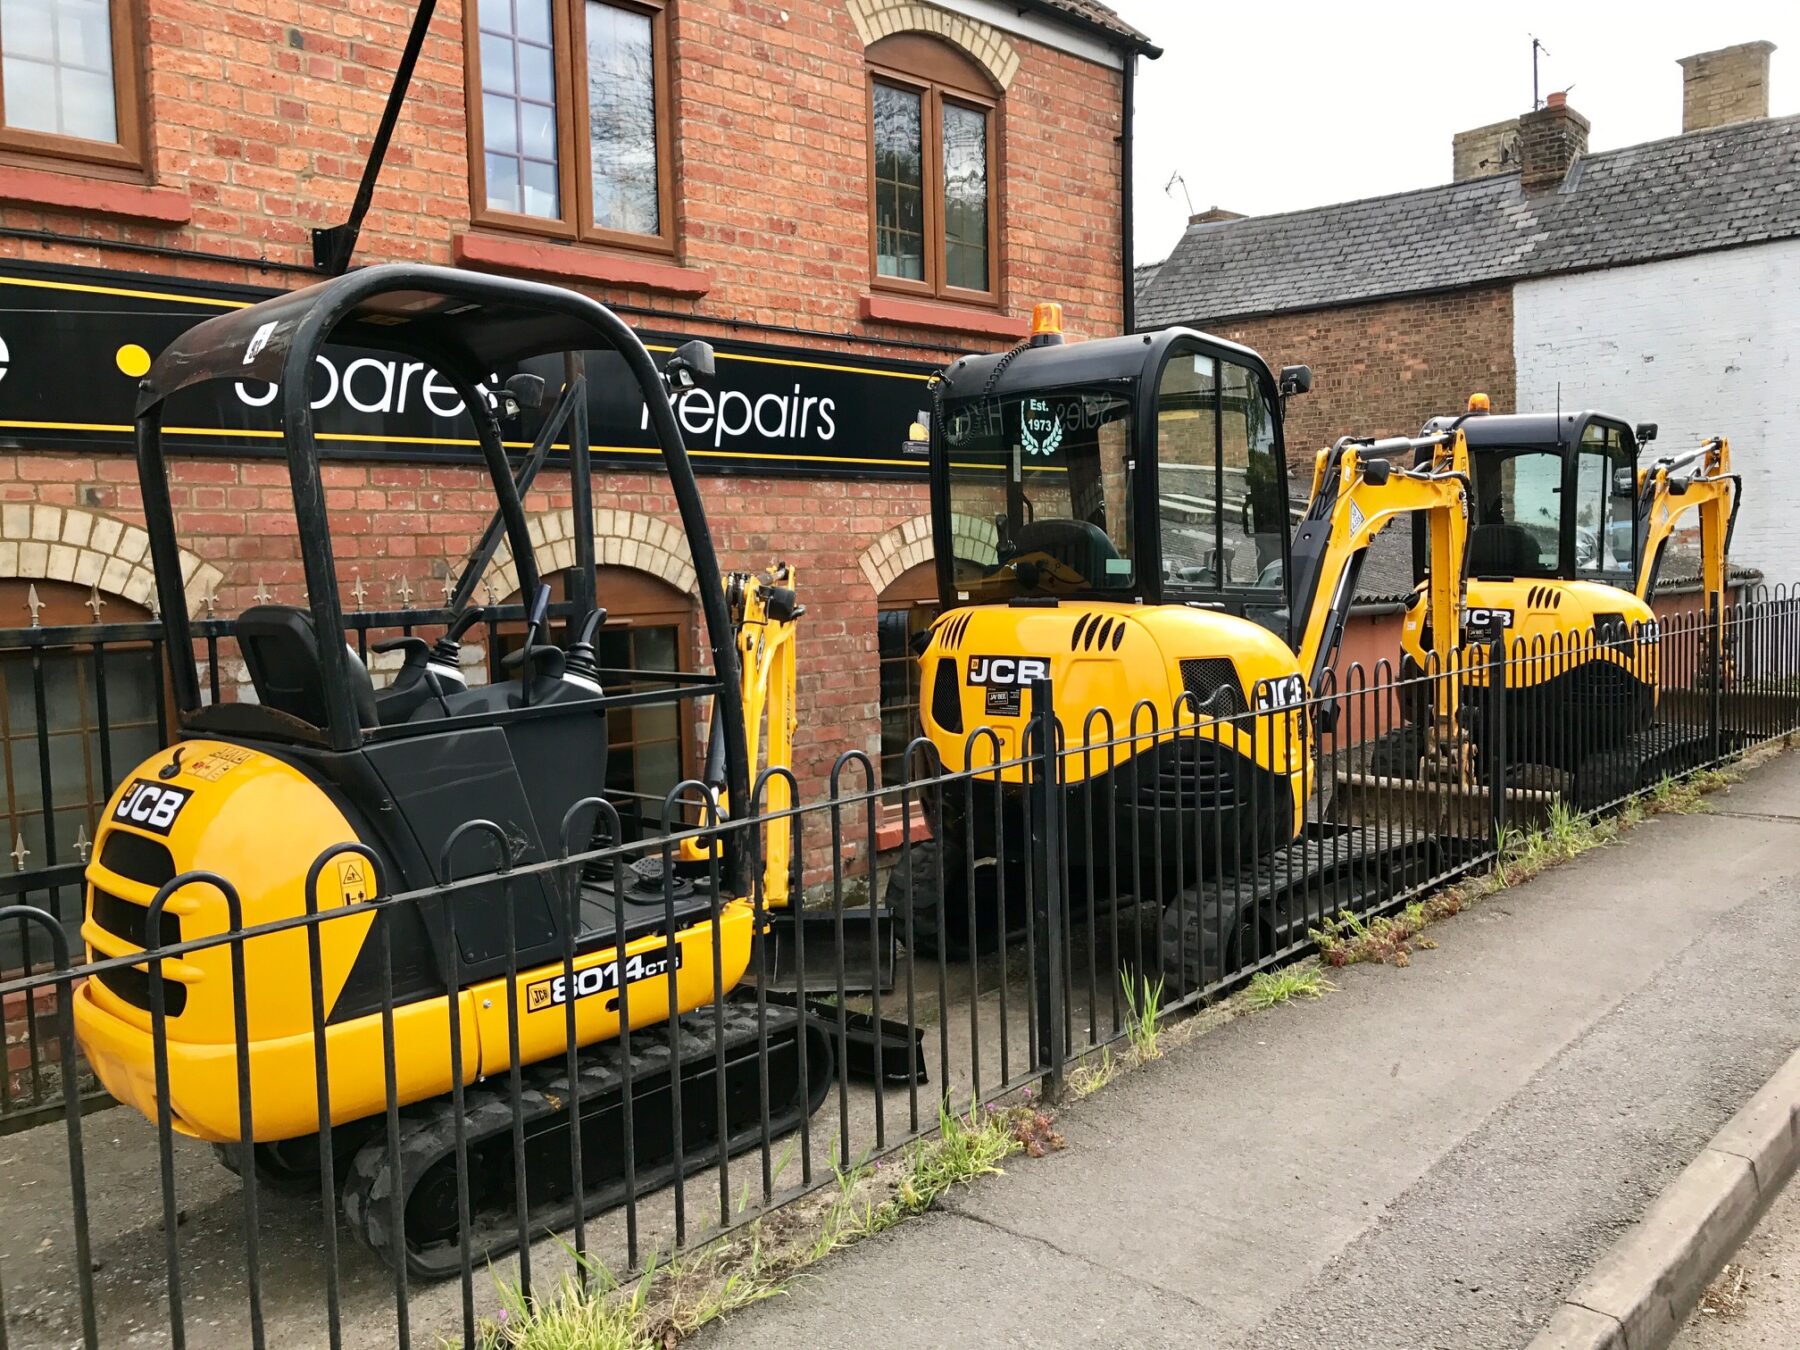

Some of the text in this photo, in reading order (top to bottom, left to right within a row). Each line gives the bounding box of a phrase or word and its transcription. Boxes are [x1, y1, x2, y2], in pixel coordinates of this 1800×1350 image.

[1030, 399, 1049, 412] Est.
[1028, 418, 1052, 431] 1973
[970, 659, 1046, 685] JCB
[117, 784, 184, 828] JCB
